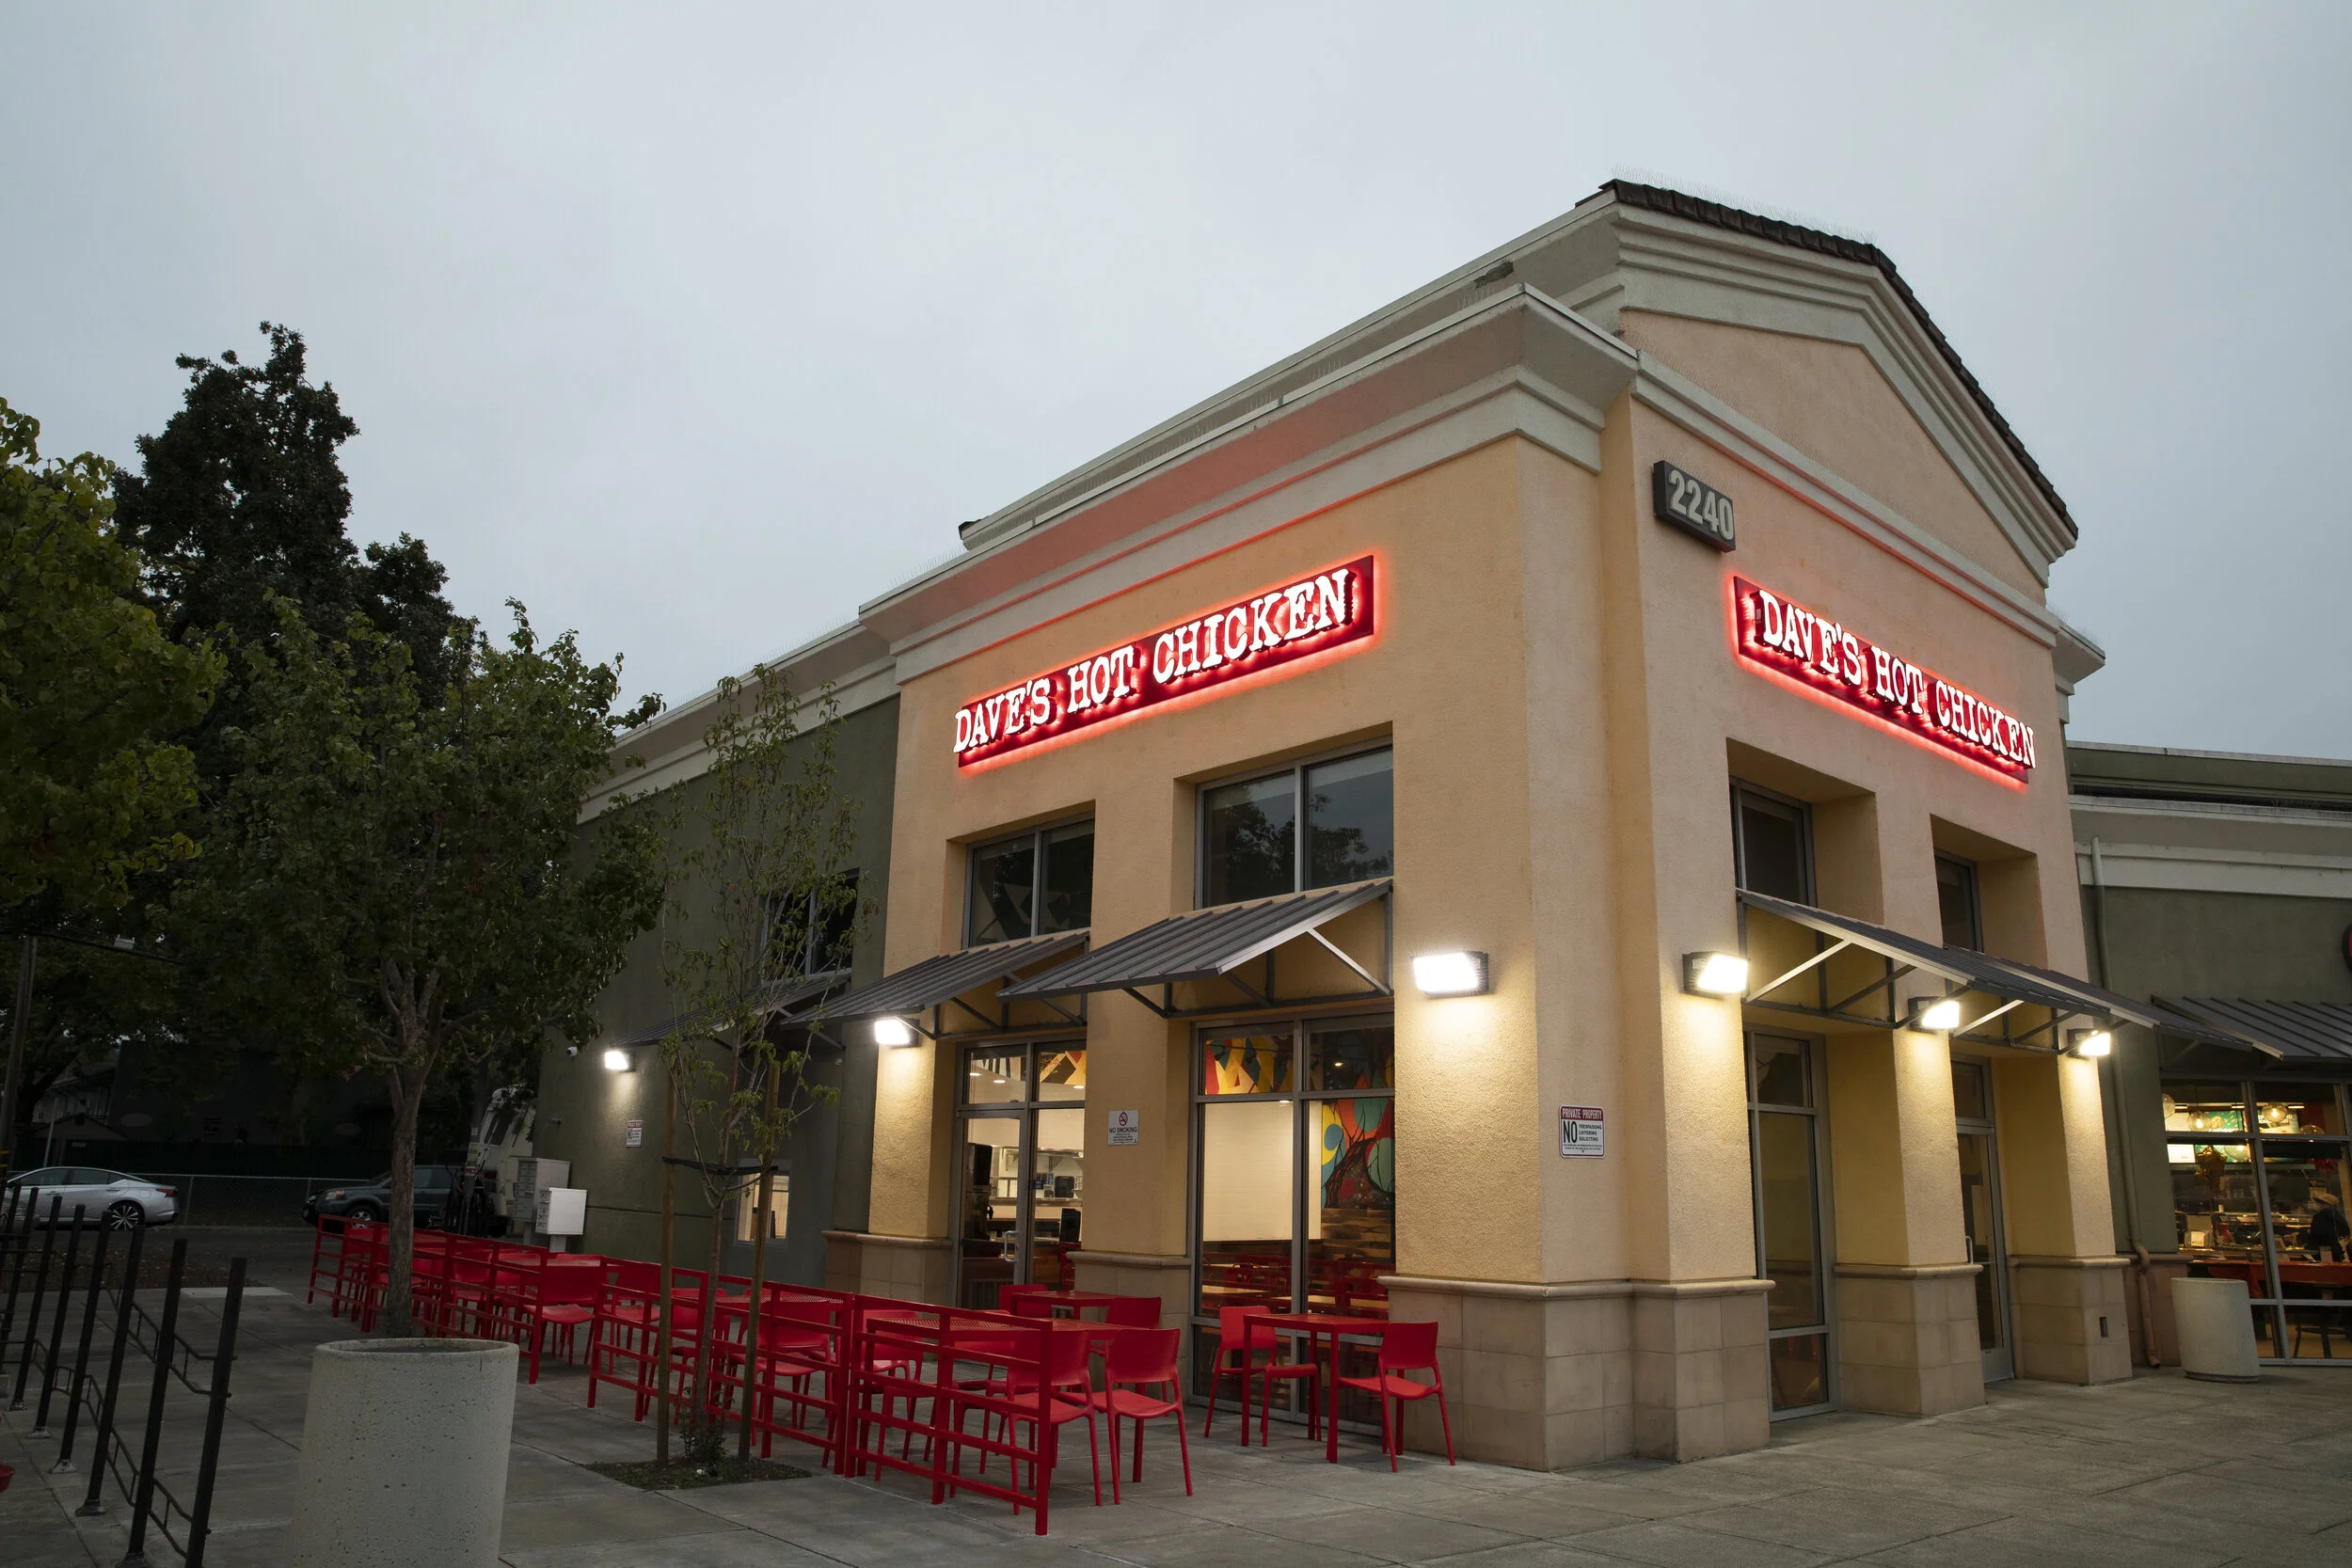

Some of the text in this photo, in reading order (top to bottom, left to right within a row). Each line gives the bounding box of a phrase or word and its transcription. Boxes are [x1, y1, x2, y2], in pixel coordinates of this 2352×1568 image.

[1668, 469, 1734, 541] 2240
[953, 568, 1350, 753] DAVE'S HOT CHICKEN
[1758, 590, 2037, 769] DAVE'S HOT CHICKEN
[1563, 1108, 1581, 1118] PRIVATE
[1563, 1120, 1577, 1143] NO
